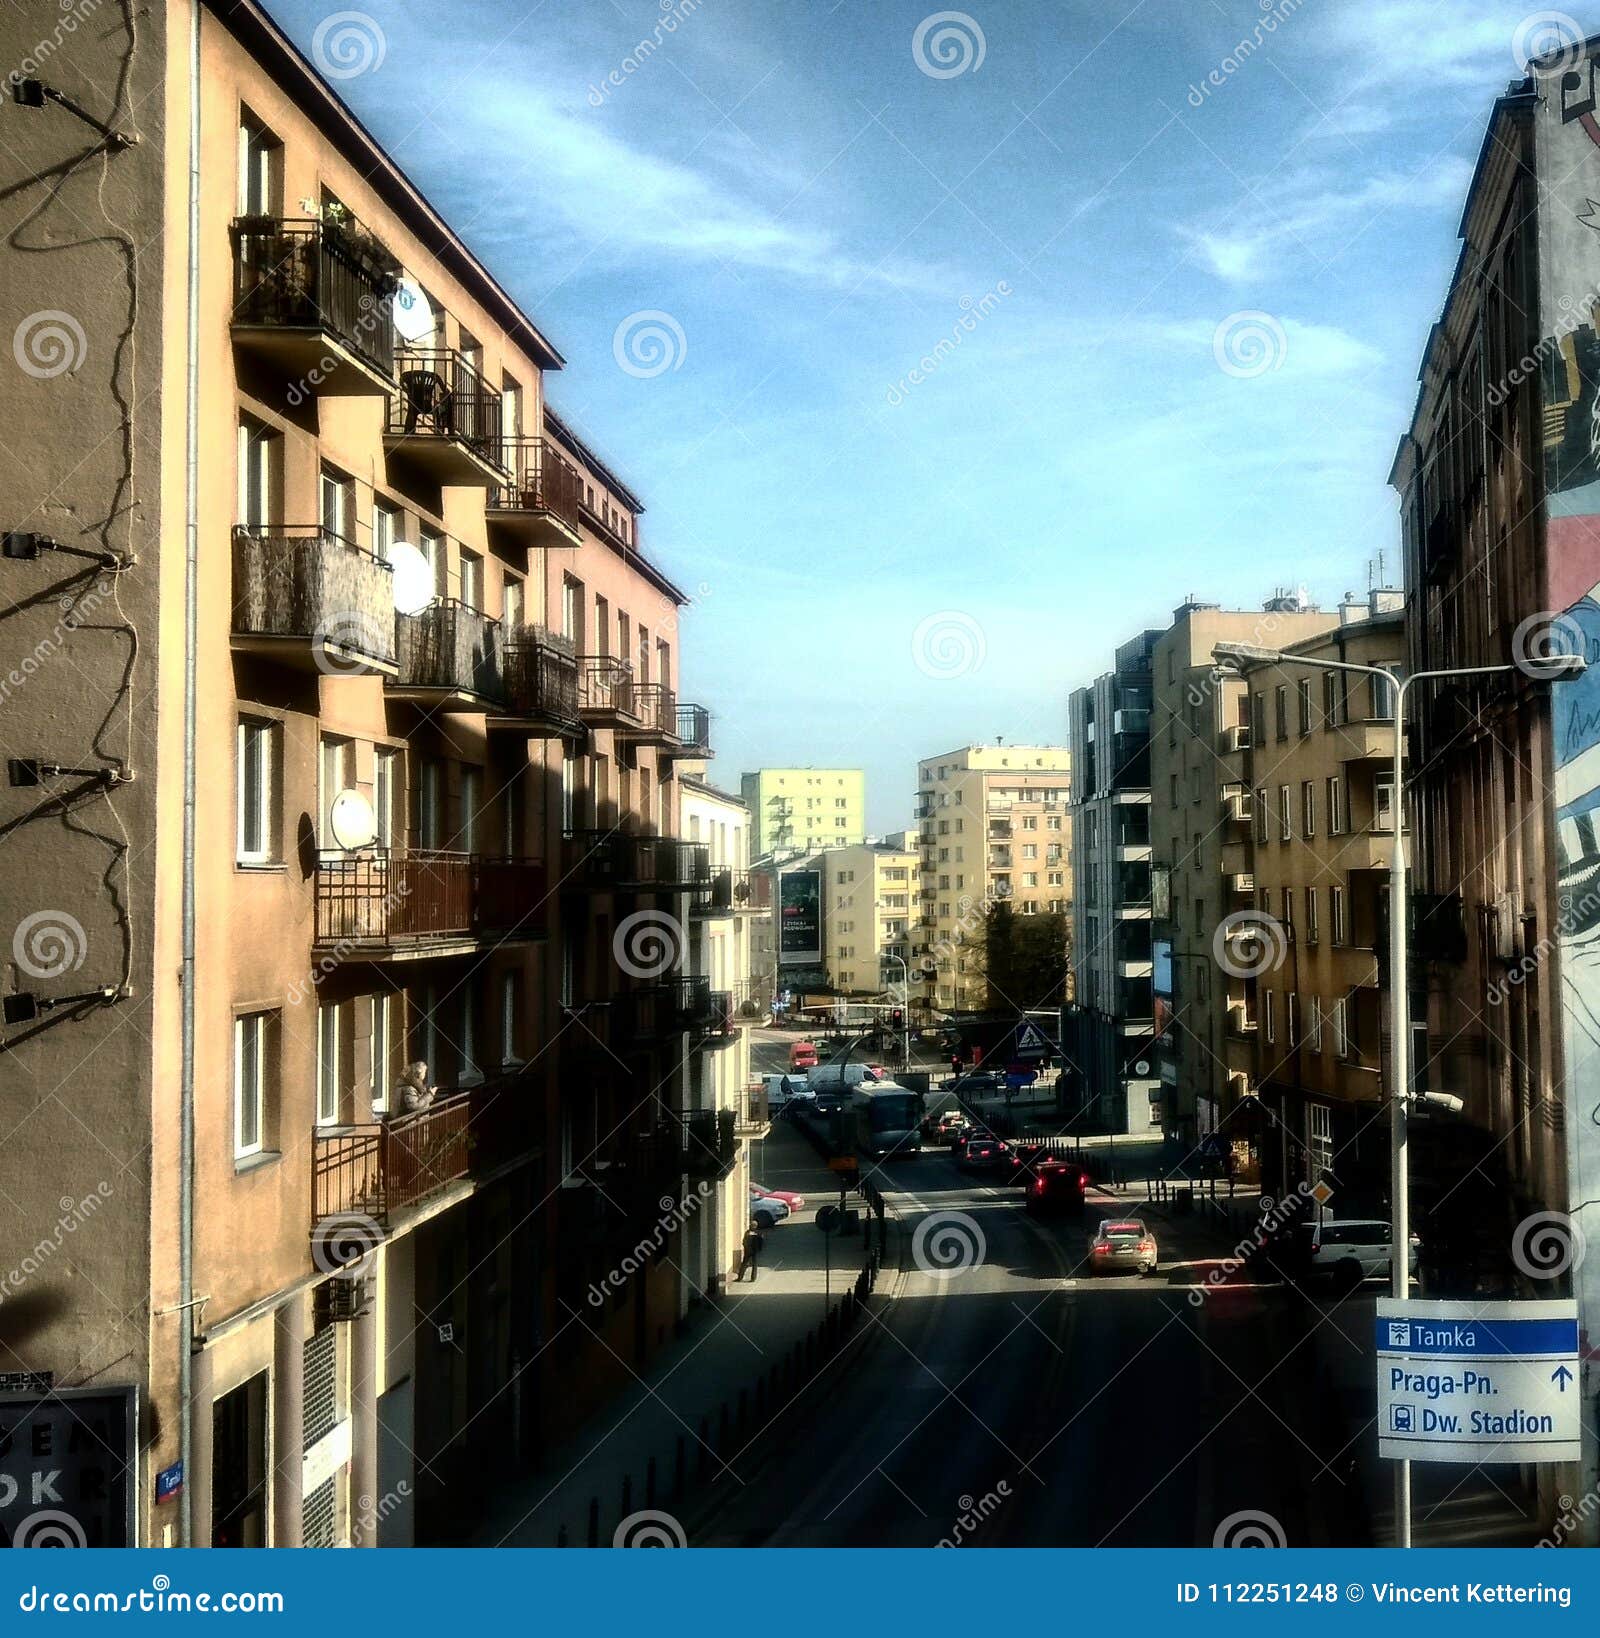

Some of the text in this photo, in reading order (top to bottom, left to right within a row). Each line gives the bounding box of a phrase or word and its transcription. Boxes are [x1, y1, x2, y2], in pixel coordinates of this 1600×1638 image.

[1414, 1326, 1476, 1347] Tamka
[1391, 1367, 1498, 1400] Praga-Pn.
[1423, 1408, 1553, 1434] Dw. Stadion
